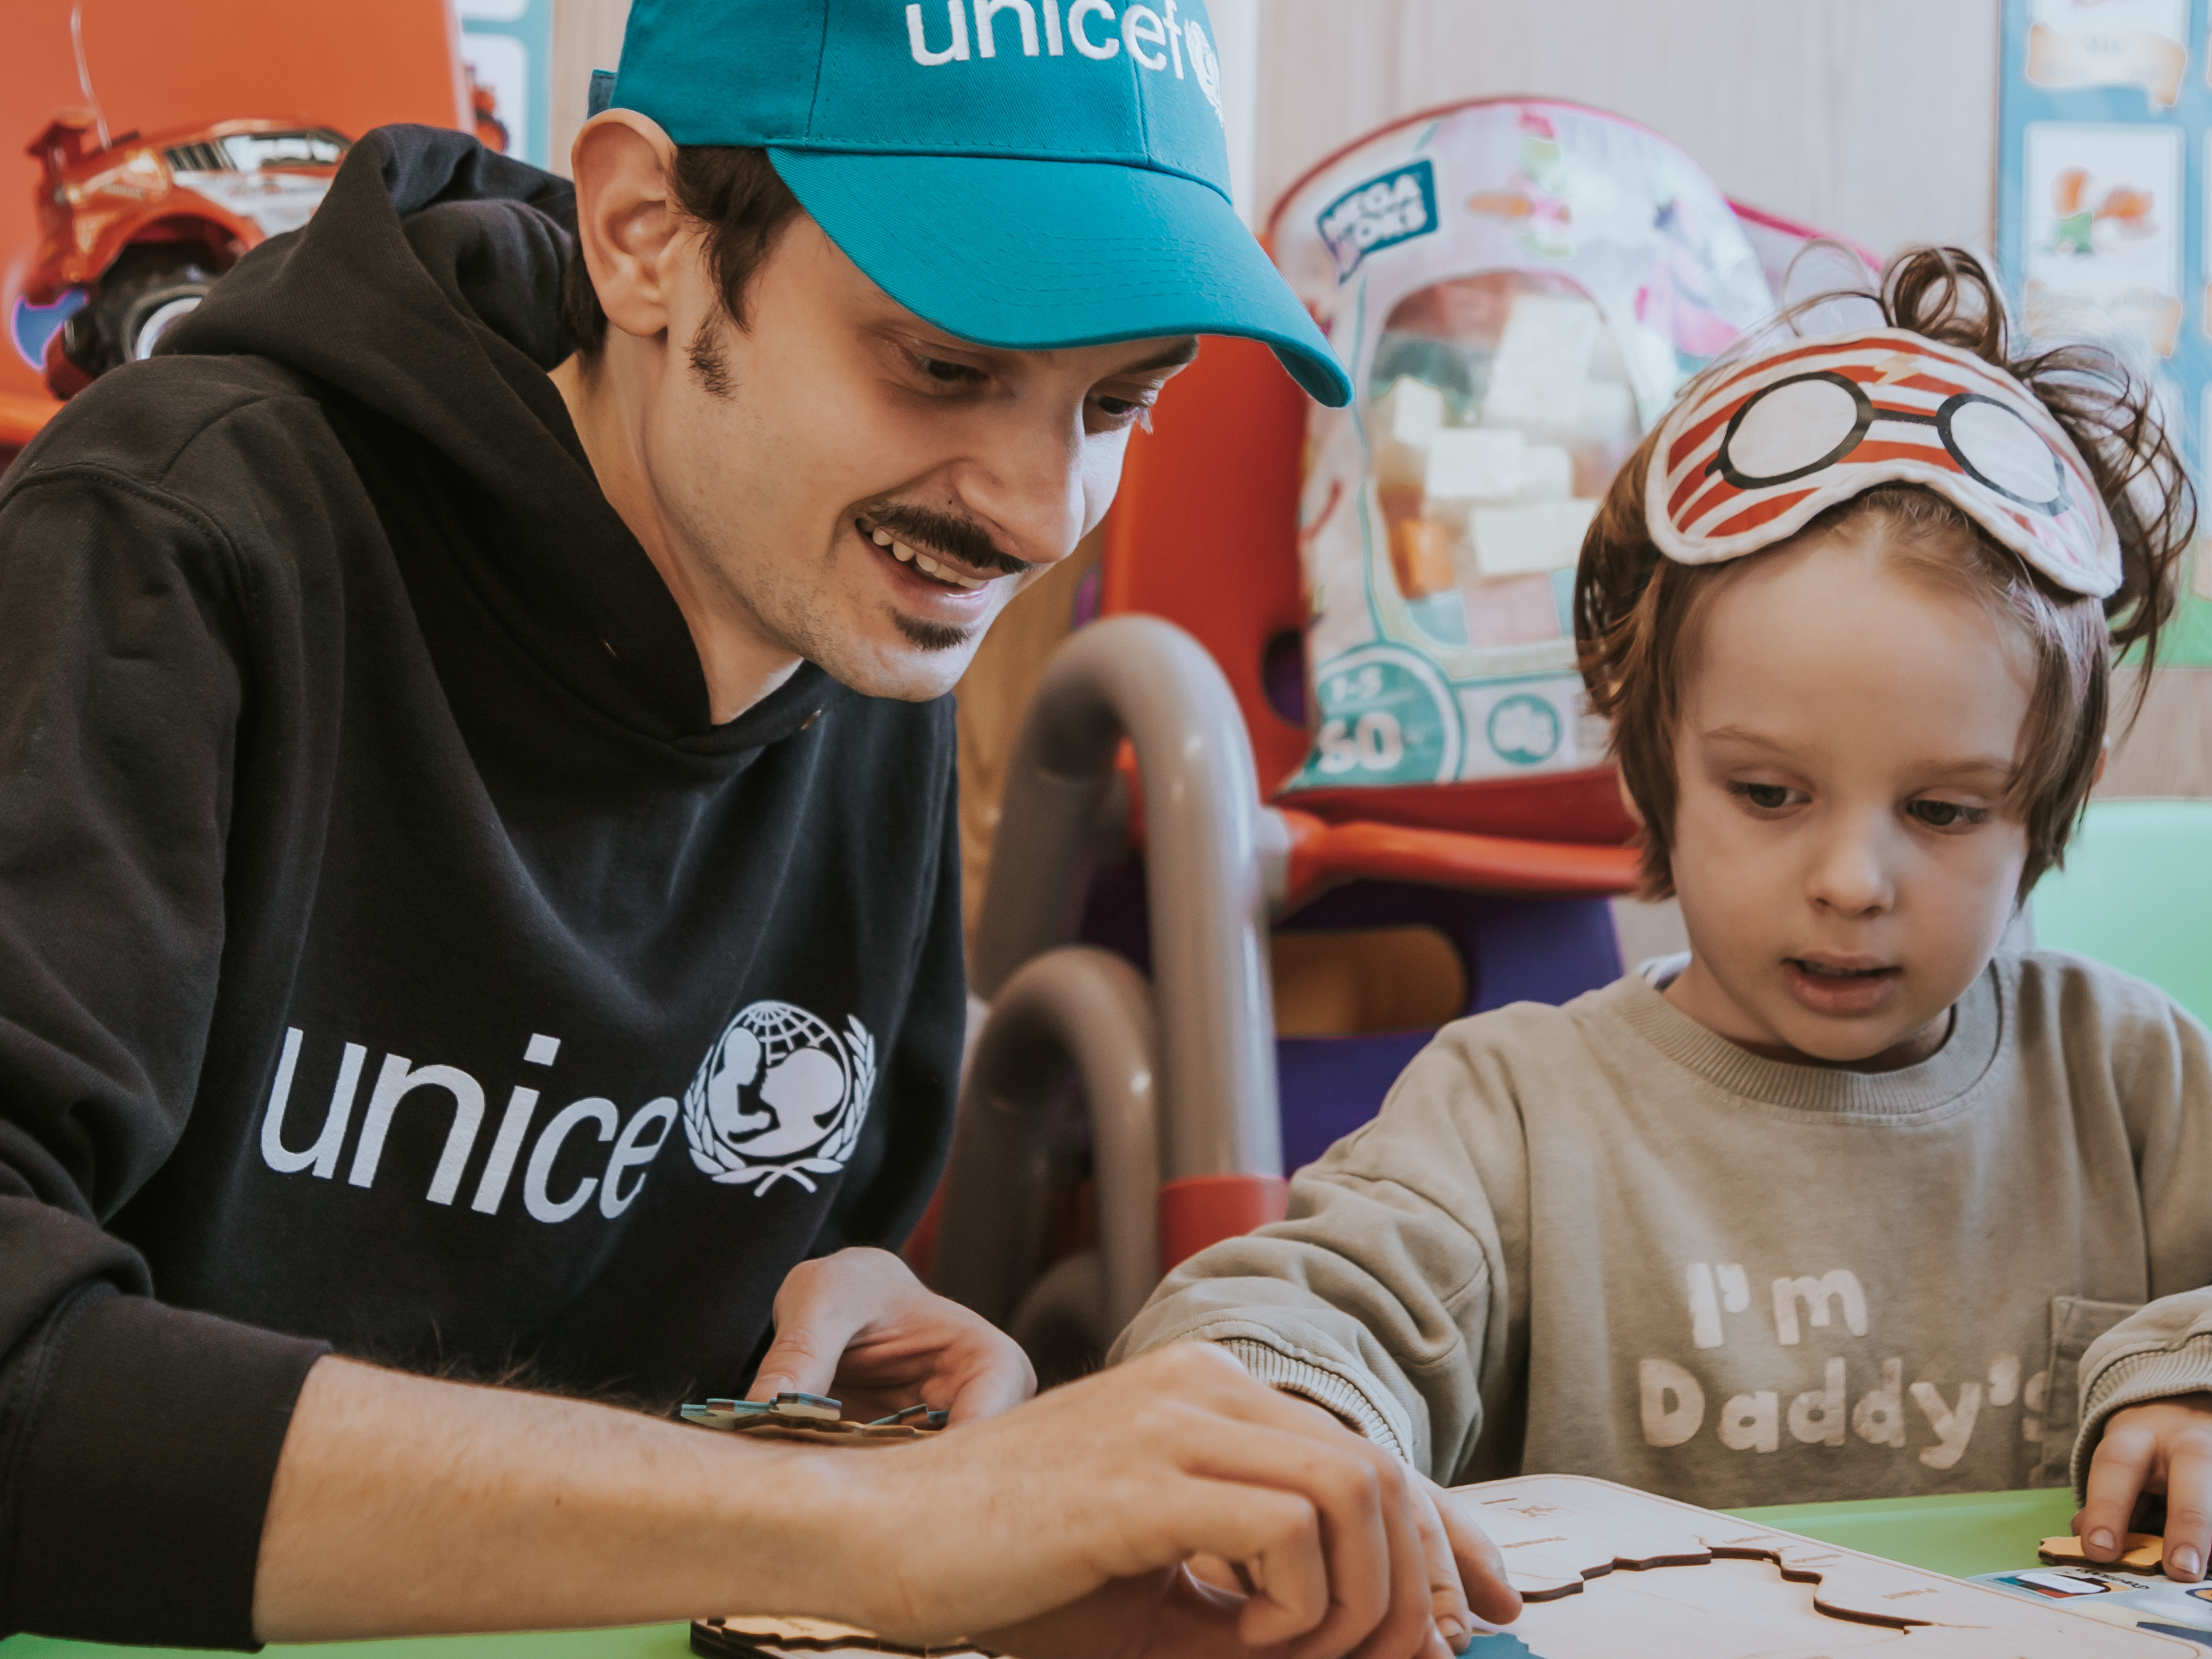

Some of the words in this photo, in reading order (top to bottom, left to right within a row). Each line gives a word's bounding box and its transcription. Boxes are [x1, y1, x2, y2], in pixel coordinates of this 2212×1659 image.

[906, 0, 1184, 80] unicef
[261, 1027, 679, 1224] unice
[1686, 1262, 1870, 1349] I'm
